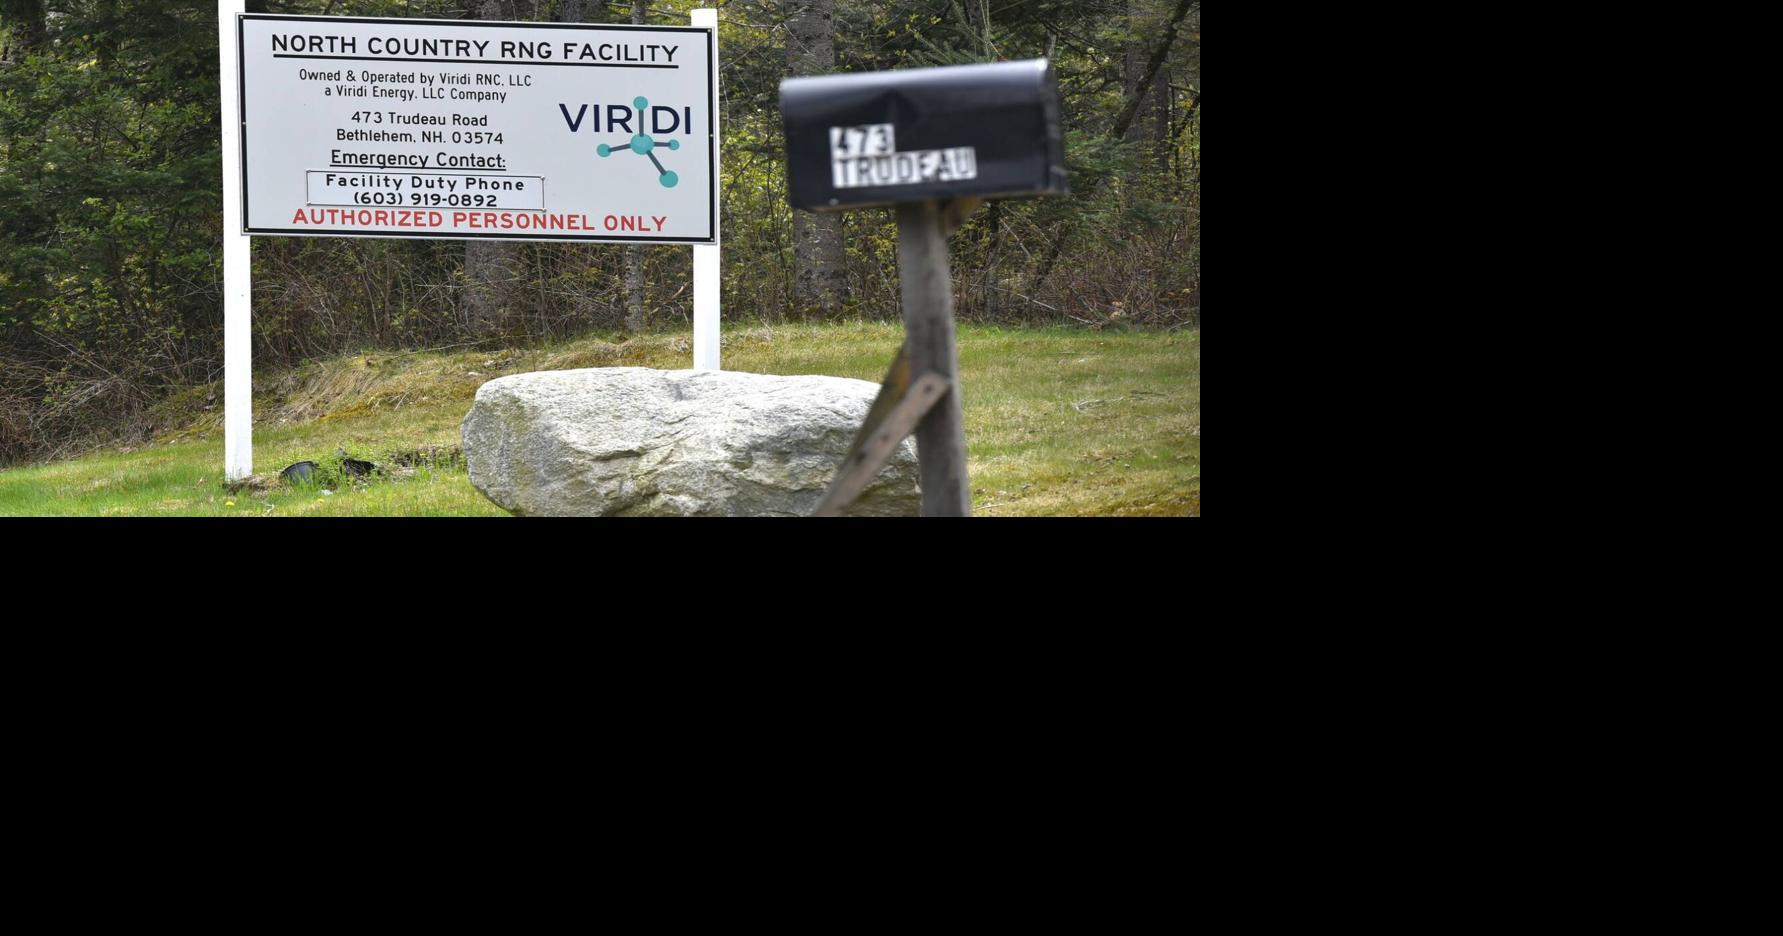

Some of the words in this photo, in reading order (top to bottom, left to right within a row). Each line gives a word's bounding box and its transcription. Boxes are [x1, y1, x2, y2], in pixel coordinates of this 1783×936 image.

[271, 33, 357, 54] NORTH
[367, 36, 490, 58] COUNTRY
[500, 40, 553, 60] RNG
[563, 42, 679, 63] FACILITY
[299, 68, 341, 82] Owned
[345, 70, 357, 82] &
[361, 70, 415, 85] Operated
[419, 72, 435, 87] by
[439, 73, 471, 85] Viridi
[509, 74, 532, 87] LLC
[324, 87, 332, 97] a
[335, 84, 367, 98] Viridi
[422, 87, 445, 100] LLC
[450, 87, 507, 104] Company
[351, 110, 383, 124] 473
[387, 111, 446, 126] Trudeau
[452, 113, 488, 127] Road
[451, 131, 504, 145] 03574
[834, 126, 891, 155] 473
[331, 149, 429, 170] Emergency
[436, 151, 506, 169] Contact:
[835, 148, 975, 187] TRUDEAU
[325, 173, 403, 192] Facility
[411, 175, 458, 193] Duty
[465, 177, 525, 191] Phone
[353, 191, 403, 206] (603)
[410, 192, 498, 208] 919-0892
[292, 208, 443, 228] AUTHORIZED
[453, 211, 596, 231] PERSONNEL
[603, 214, 667, 232] ONLY
